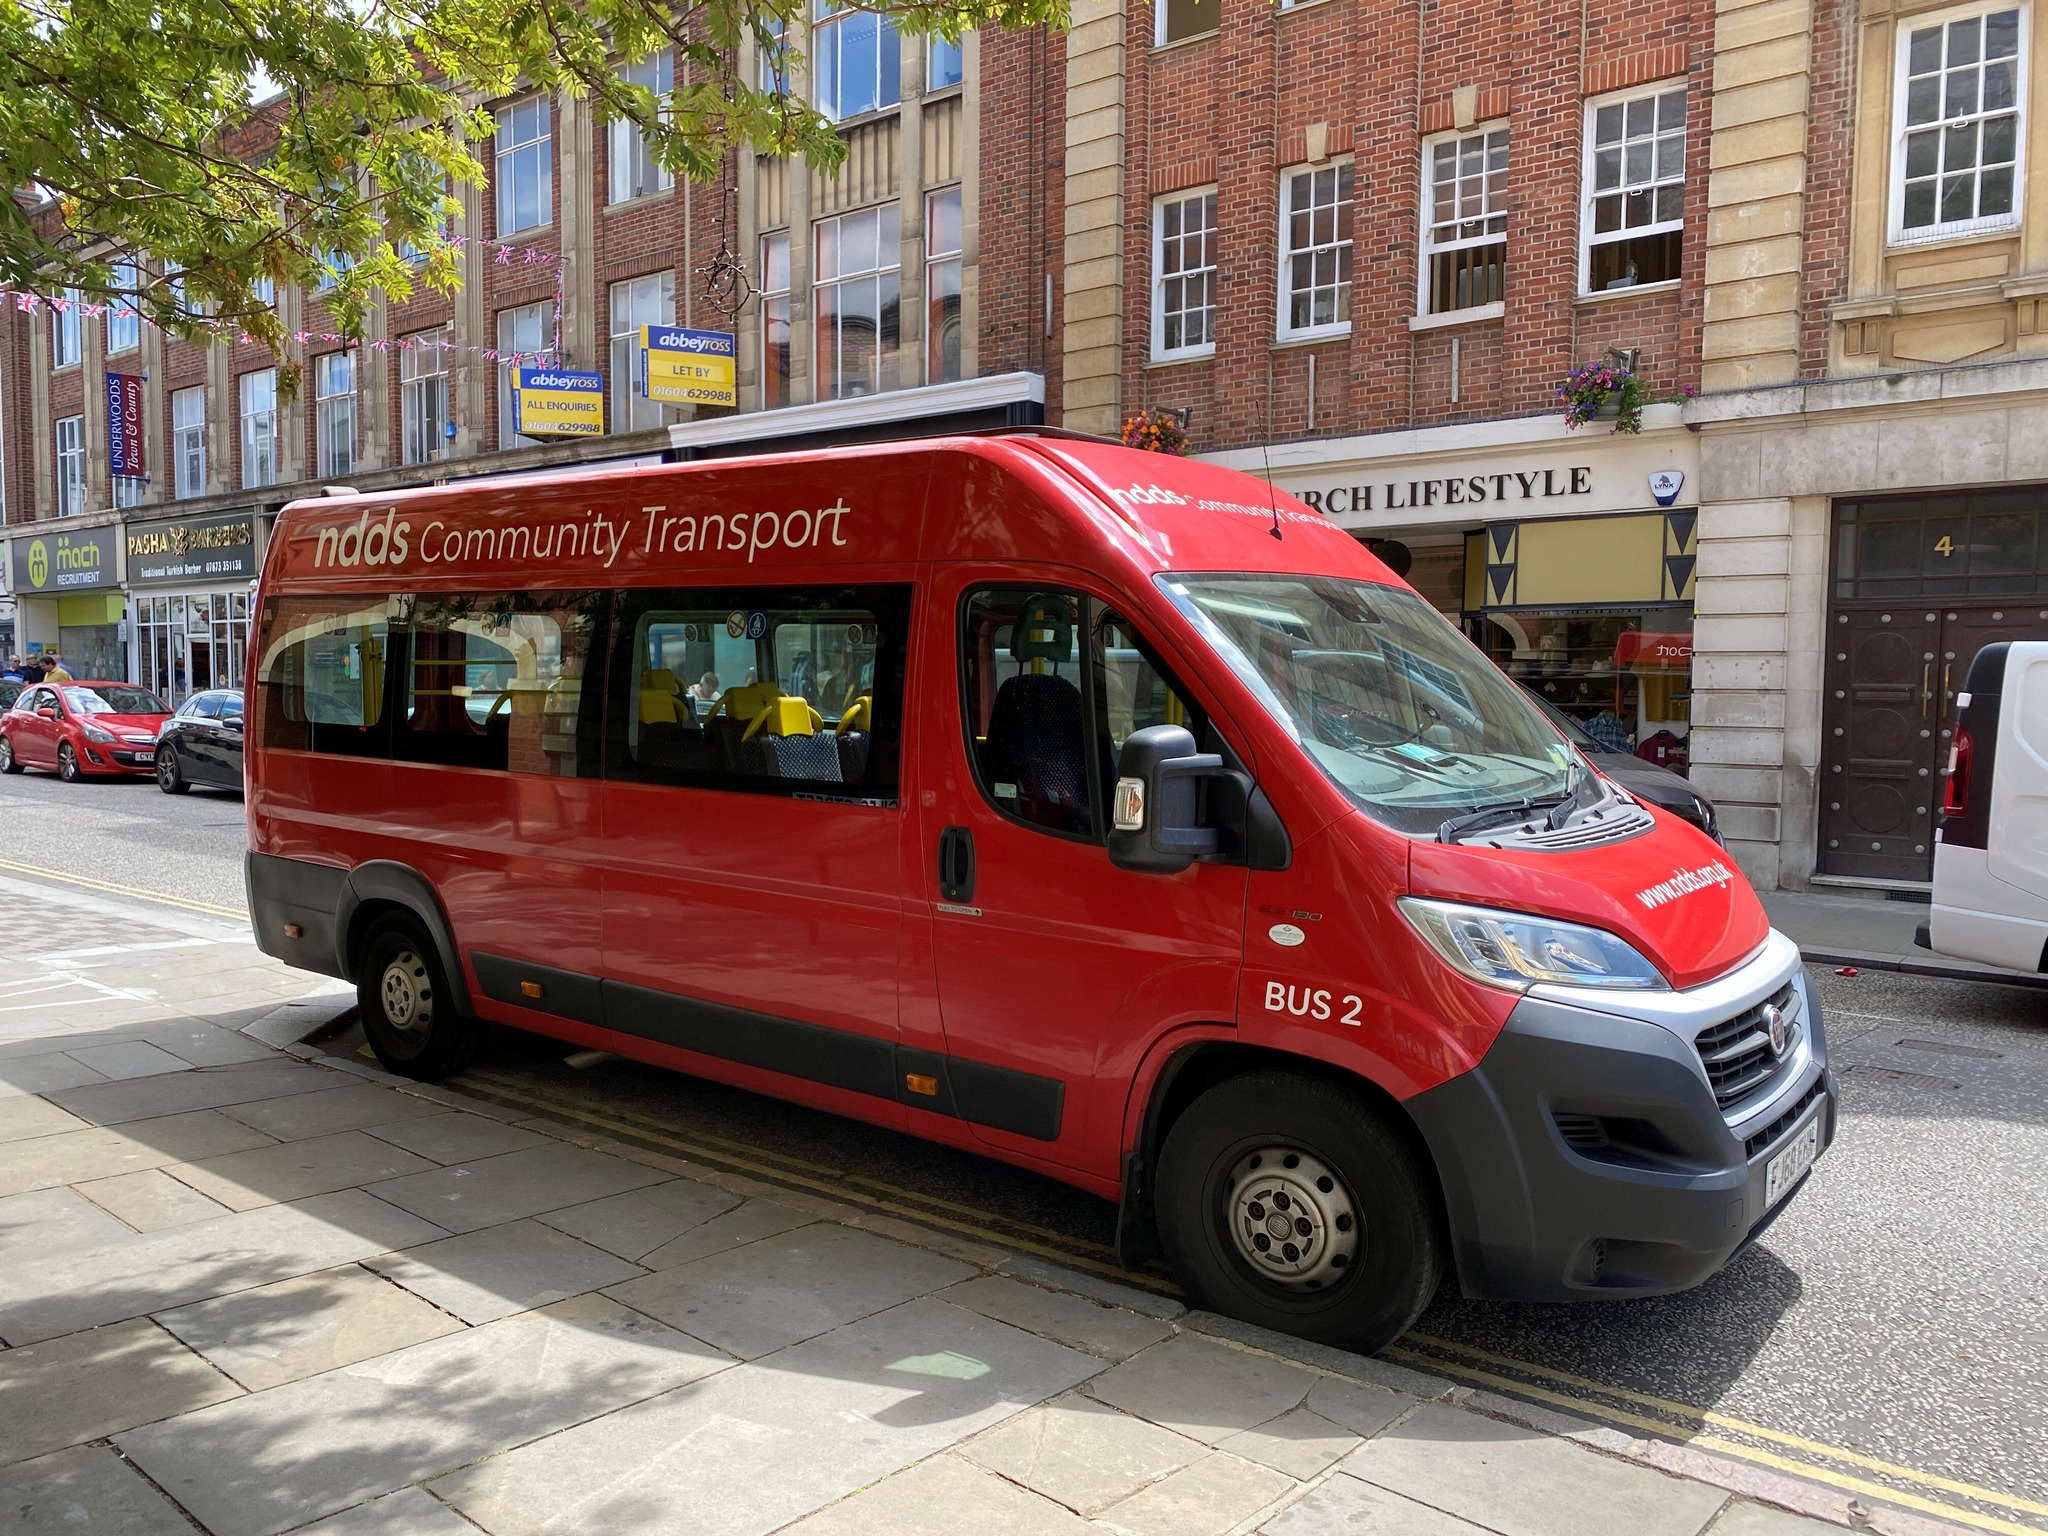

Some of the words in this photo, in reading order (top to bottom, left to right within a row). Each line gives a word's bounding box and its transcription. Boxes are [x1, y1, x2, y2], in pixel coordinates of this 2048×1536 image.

[659, 332, 731, 353] abbeyross
[530, 373, 598, 390] abbeyross
[673, 364, 692, 377] LET
[696, 365, 710, 378] BY
[125, 381, 140, 421] County
[653, 385, 732, 401] 01604629988
[527, 400, 546, 410] ALL
[547, 401, 597, 412] ENQUIRIES
[109, 379, 124, 468] UNDERWOODS
[125, 422, 138, 436] &
[525, 421, 600, 433] 01604629988
[127, 439, 139, 470] Town
[1294, 485, 1374, 514] RCH
[1384, 466, 1591, 509] LIFESTYLE
[1111, 482, 1187, 506] ndds
[1184, 495, 1287, 524] Community
[314, 506, 410, 567] ndds
[419, 509, 631, 568] Community
[641, 497, 851, 563] Transport
[128, 532, 169, 556] PASHA
[1934, 535, 1954, 557] 4
[57, 571, 100, 586] RECRUITMENT
[141, 566, 166, 578] Traditional
[167, 564, 184, 576] Turkish
[185, 563, 202, 575] Barber
[1635, 858, 1734, 909] www.ndds.org.uk
[1265, 981, 1332, 1020] BUS
[1340, 995, 1363, 1027] 2
